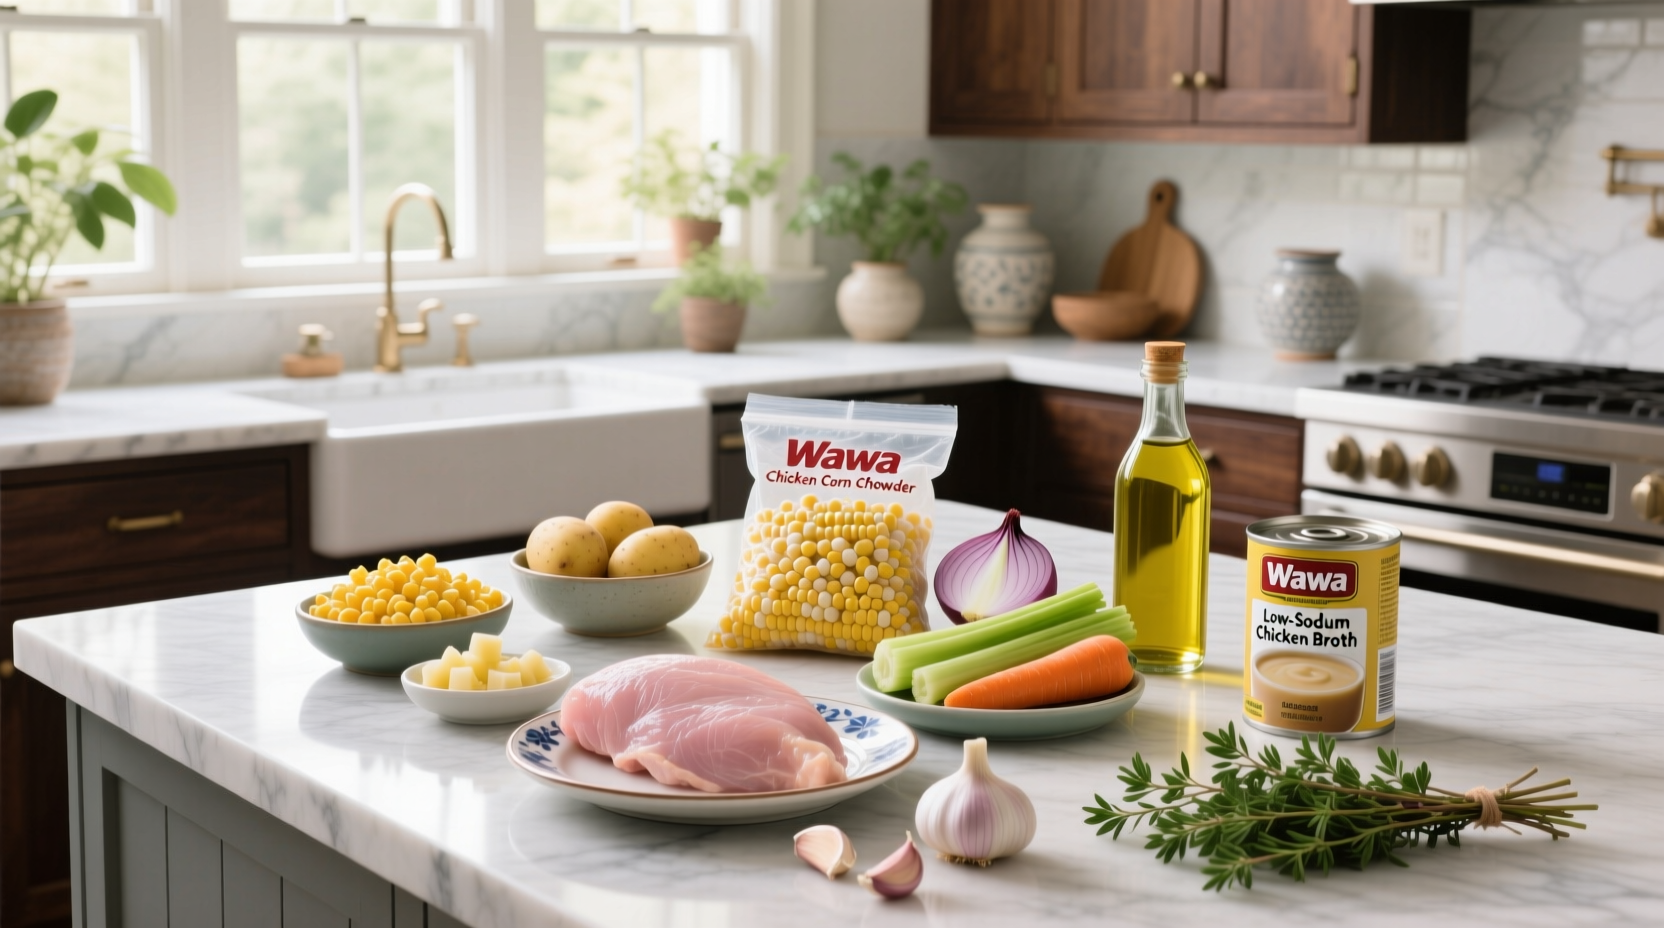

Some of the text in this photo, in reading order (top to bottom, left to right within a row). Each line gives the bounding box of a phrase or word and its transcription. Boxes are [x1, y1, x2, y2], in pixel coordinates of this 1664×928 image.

[787, 439, 902, 474] Wawa
[766, 470, 916, 494] Chicken Corn Chowder
[1267, 561, 1347, 592] Wawa
[1256, 625, 1357, 648] Chicken Broth
